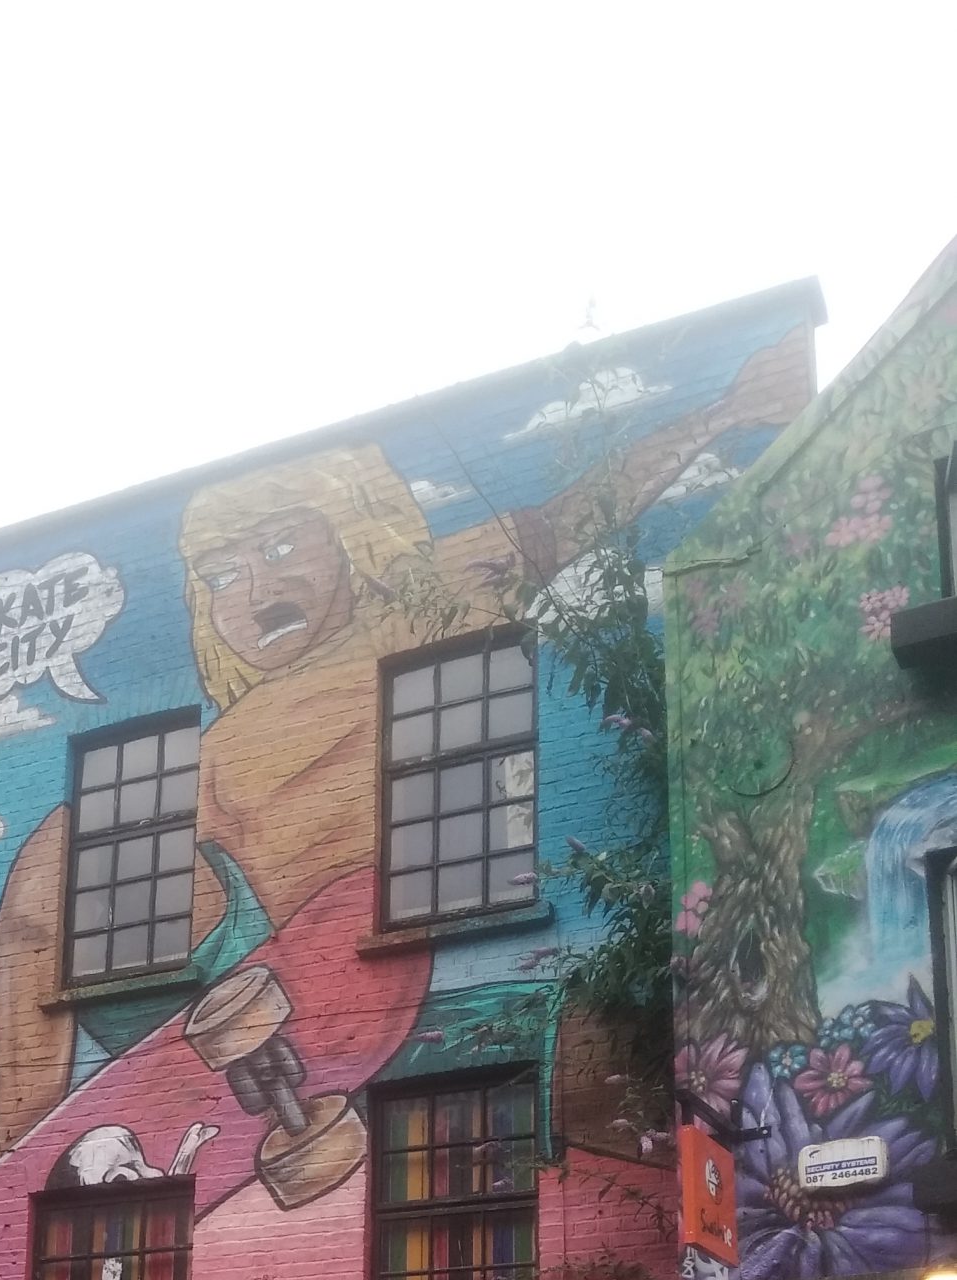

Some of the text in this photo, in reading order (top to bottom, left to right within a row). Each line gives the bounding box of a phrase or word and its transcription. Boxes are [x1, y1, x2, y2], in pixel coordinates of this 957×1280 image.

[807, 1159, 876, 1172] SECURITY SYSTEMS
[806, 1167, 878, 1184] 087 2464482
